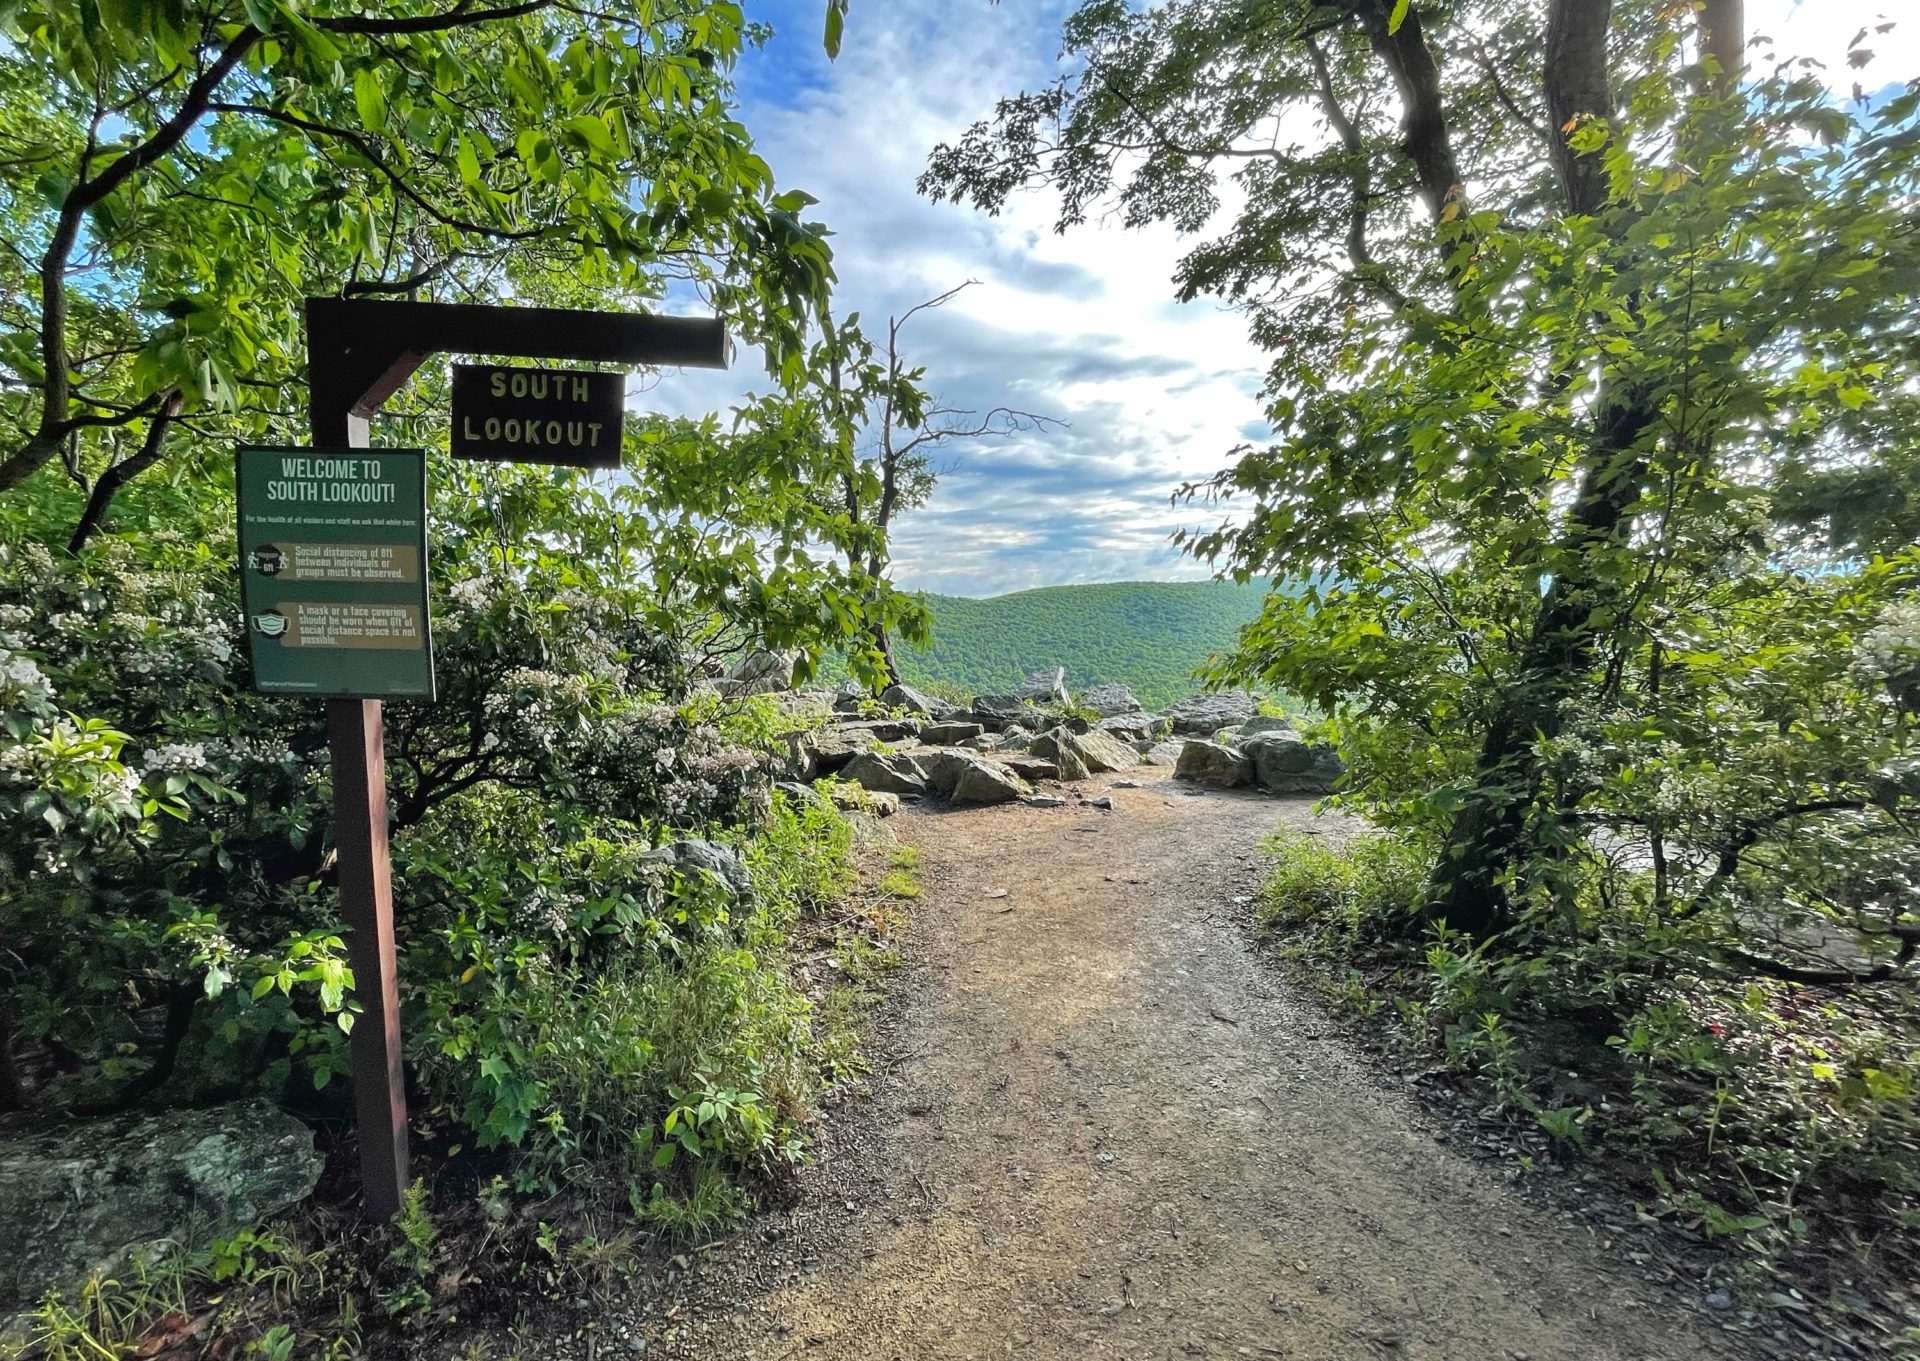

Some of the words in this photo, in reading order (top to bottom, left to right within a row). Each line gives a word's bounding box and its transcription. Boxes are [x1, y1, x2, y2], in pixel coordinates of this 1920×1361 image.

[490, 372, 588, 402] SOUTH
[464, 416, 602, 446] LOOKOUT
[282, 458, 358, 479] WELCOME
[362, 460, 380, 480] TO
[267, 481, 317, 501] SOUTH
[322, 483, 395, 502] LOOKOUT!
[294, 516, 302, 524] all
[386, 518, 400, 526] while
[296, 546, 320, 557] Social
[324, 547, 367, 558] distancing
[370, 548, 379, 558] of
[381, 548, 393, 558] 6ft
[263, 563, 273, 572] 6ft
[296, 557, 330, 566] between
[334, 558, 378, 568] individuals
[296, 568, 324, 578] groups
[328, 568, 348, 577] must
[352, 568, 361, 577] be
[364, 569, 404, 578] observed.
[298, 605, 304, 615] A
[307, 606, 329, 615] mask
[332, 608, 340, 616] or
[343, 608, 348, 616] a
[351, 606, 368, 616] face
[372, 608, 406, 618] covering
[300, 615, 326, 625] should
[329, 616, 339, 625] be
[342, 618, 362, 626] worn
[366, 616, 387, 626] when
[390, 617, 402, 626] 6ft
[405, 617, 413, 627] of
[300, 625, 325, 634] social
[327, 626, 362, 635] distance
[365, 628, 389, 637] space
[392, 627, 400, 636] is
[402, 628, 416, 637] not
[301, 635, 338, 645] possible.
